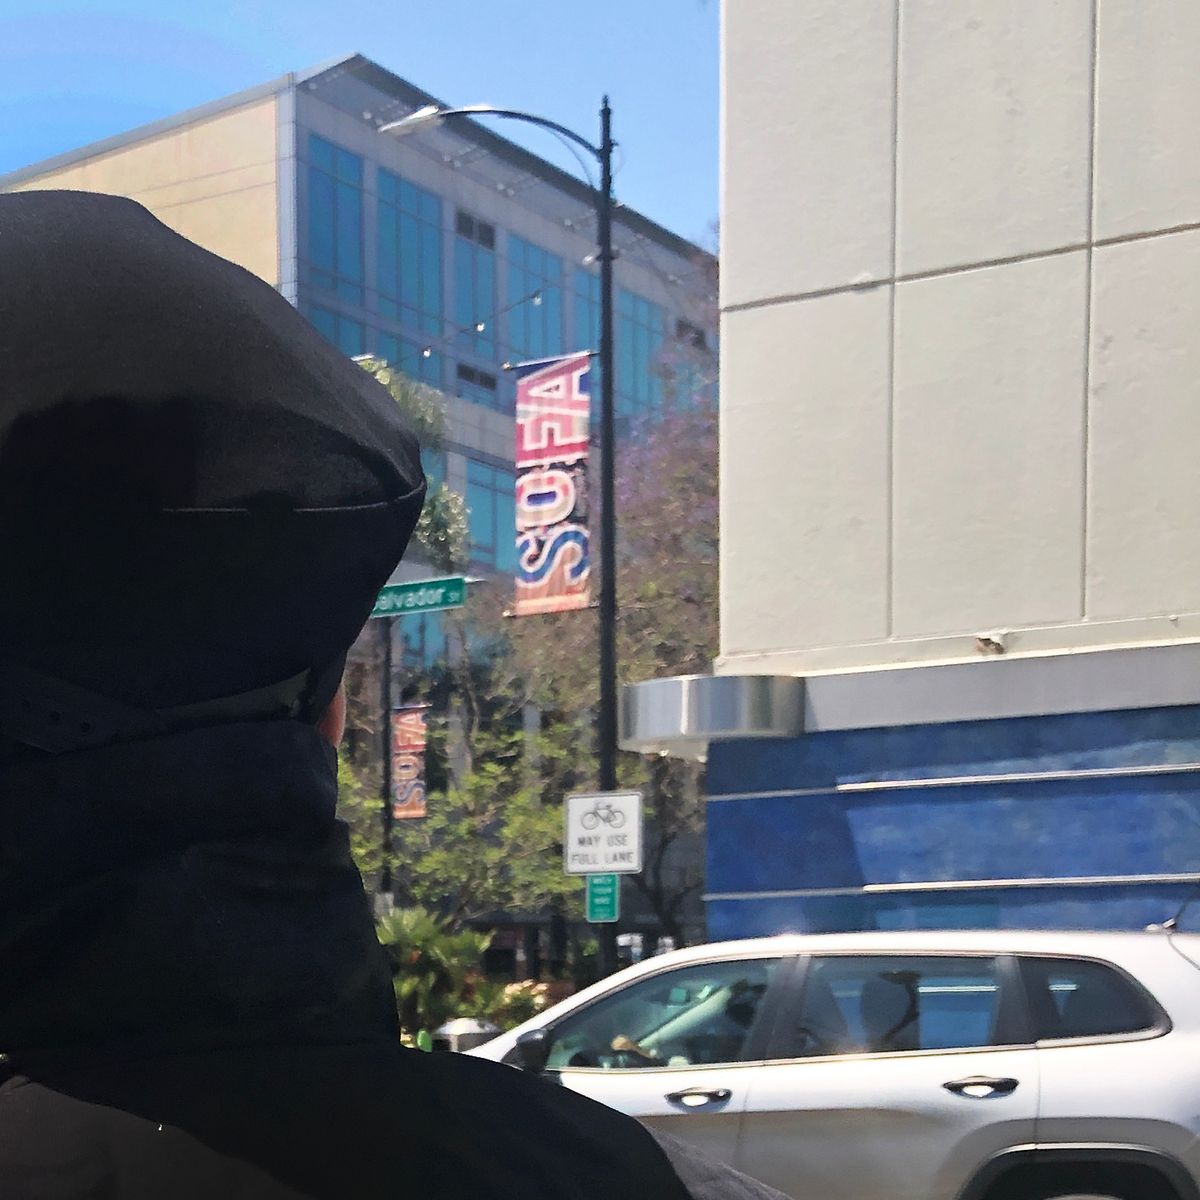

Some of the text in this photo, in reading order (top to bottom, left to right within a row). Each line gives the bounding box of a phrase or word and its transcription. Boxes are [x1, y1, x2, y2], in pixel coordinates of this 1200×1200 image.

[376, 588, 445, 611] alvador
[578, 834, 628, 847] MAY USE
[605, 851, 634, 864] LANE
